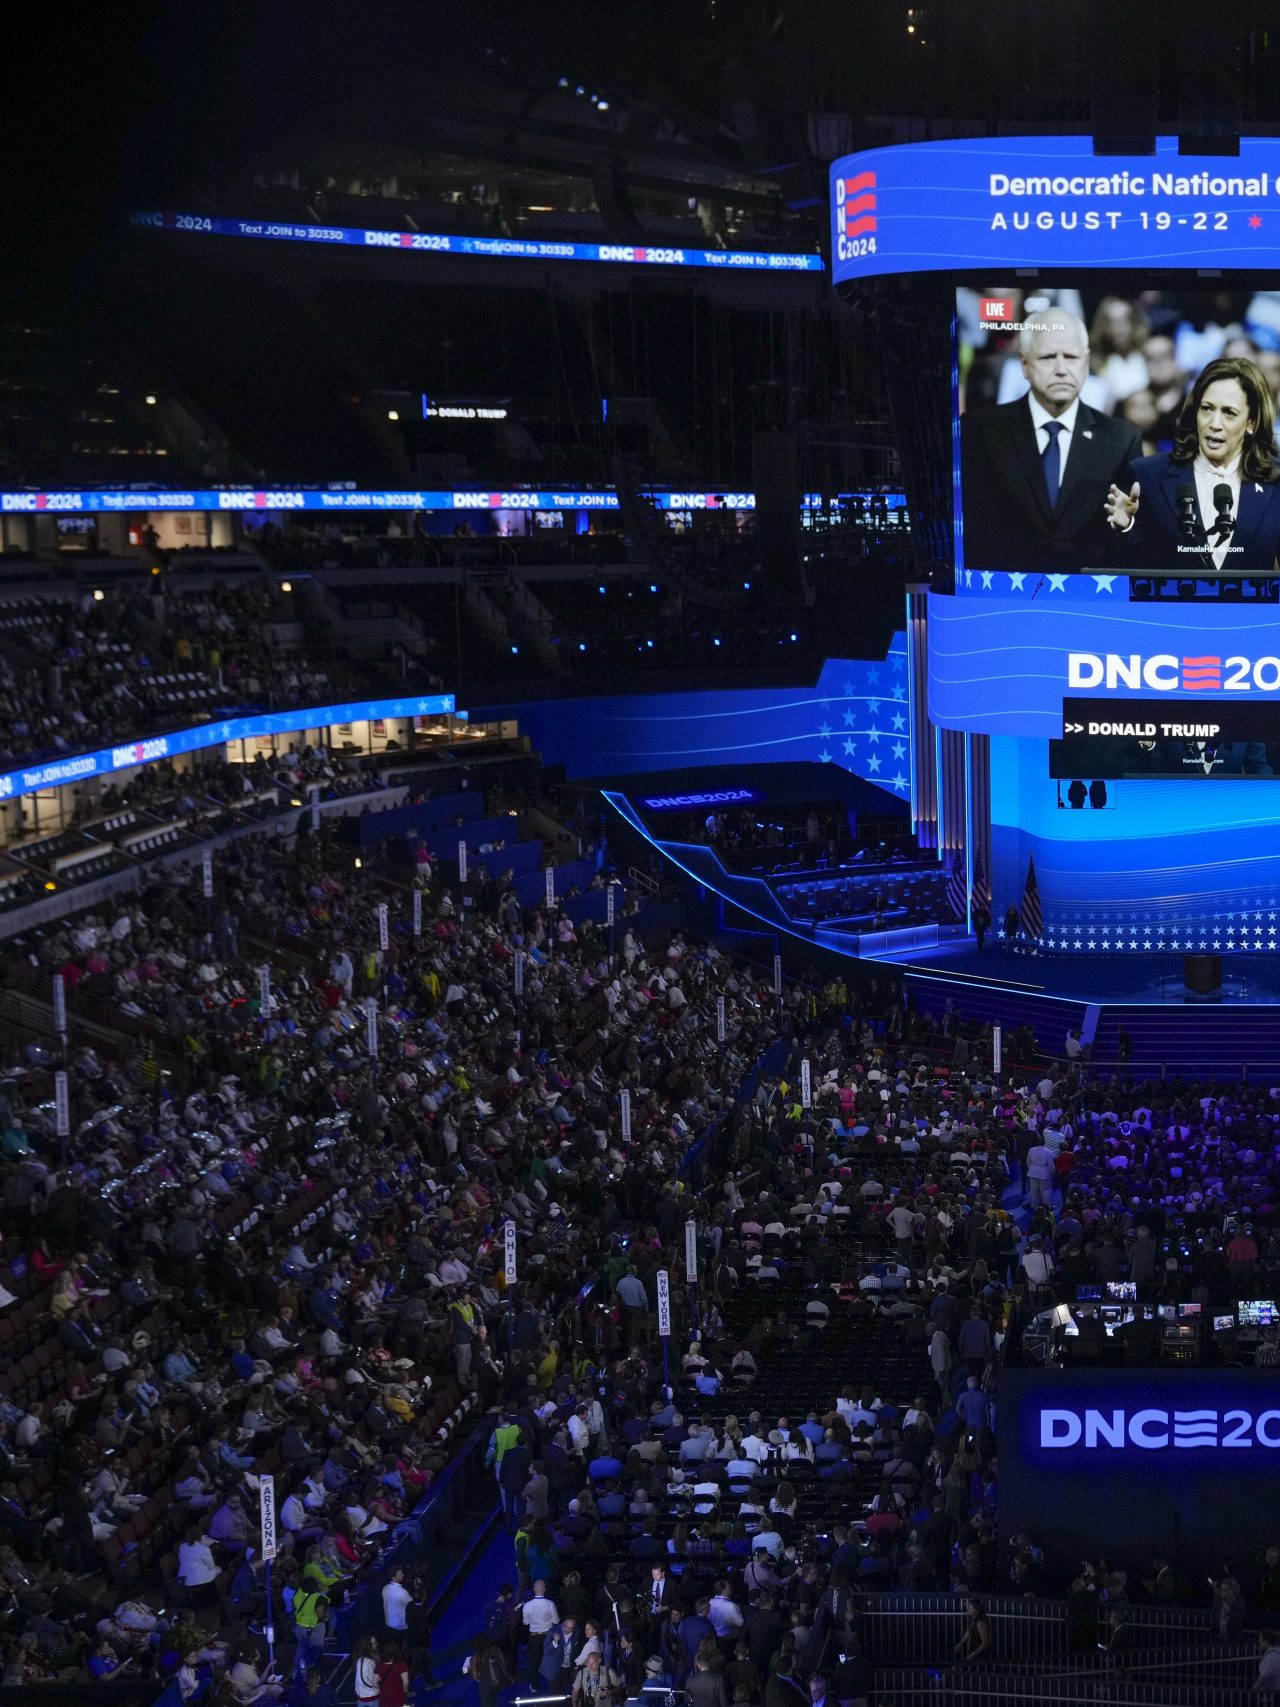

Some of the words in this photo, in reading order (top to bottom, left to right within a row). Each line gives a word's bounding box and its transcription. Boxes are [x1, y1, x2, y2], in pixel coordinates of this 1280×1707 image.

[990, 171, 1144, 195] Democratic
[1153, 172, 1267, 196] National
[176, 216, 212, 230] 2024
[992, 212, 1121, 229] AUGUST
[1141, 212, 1227, 230] 19-22
[239, 224, 262, 233] Text
[265, 226, 292, 236] JOIN
[295, 229, 306, 237] to
[308, 229, 343, 239] 30330
[365, 232, 401, 246] DNC
[411, 235, 450, 249] 2024
[845, 237, 876, 258] 2024
[599, 246, 635, 261] DNC
[645, 249, 684, 263] 2024
[728, 255, 754, 264] JOIN
[986, 303, 1004, 316] LIVE
[979, 321, 1049, 332] PHILADELPHIA,
[1052, 324, 1065, 332] PA
[2, 494, 38, 510] DNC
[45, 495, 82, 509] 2024
[219, 493, 256, 508] DNC
[265, 493, 304, 507] 2024
[454, 493, 489, 508] DNC
[500, 494, 539, 507] 2024
[553, 496, 575, 505] Text
[577, 496, 604, 505] JOIN
[606, 497, 618, 505] to
[670, 494, 706, 508] DNC
[1069, 654, 1178, 690] DNC
[1089, 723, 1156, 735] DONALD
[1161, 724, 1219, 736] TRUMP
[113, 746, 137, 767] DNC
[704, 790, 752, 802] 2024
[506, 1228, 515, 1276] OHIO
[658, 1278, 668, 1298] NEW
[660, 1301, 669, 1328] YORK
[1041, 1409, 1169, 1449] DNC
[264, 1486, 274, 1547] ARIZONA
